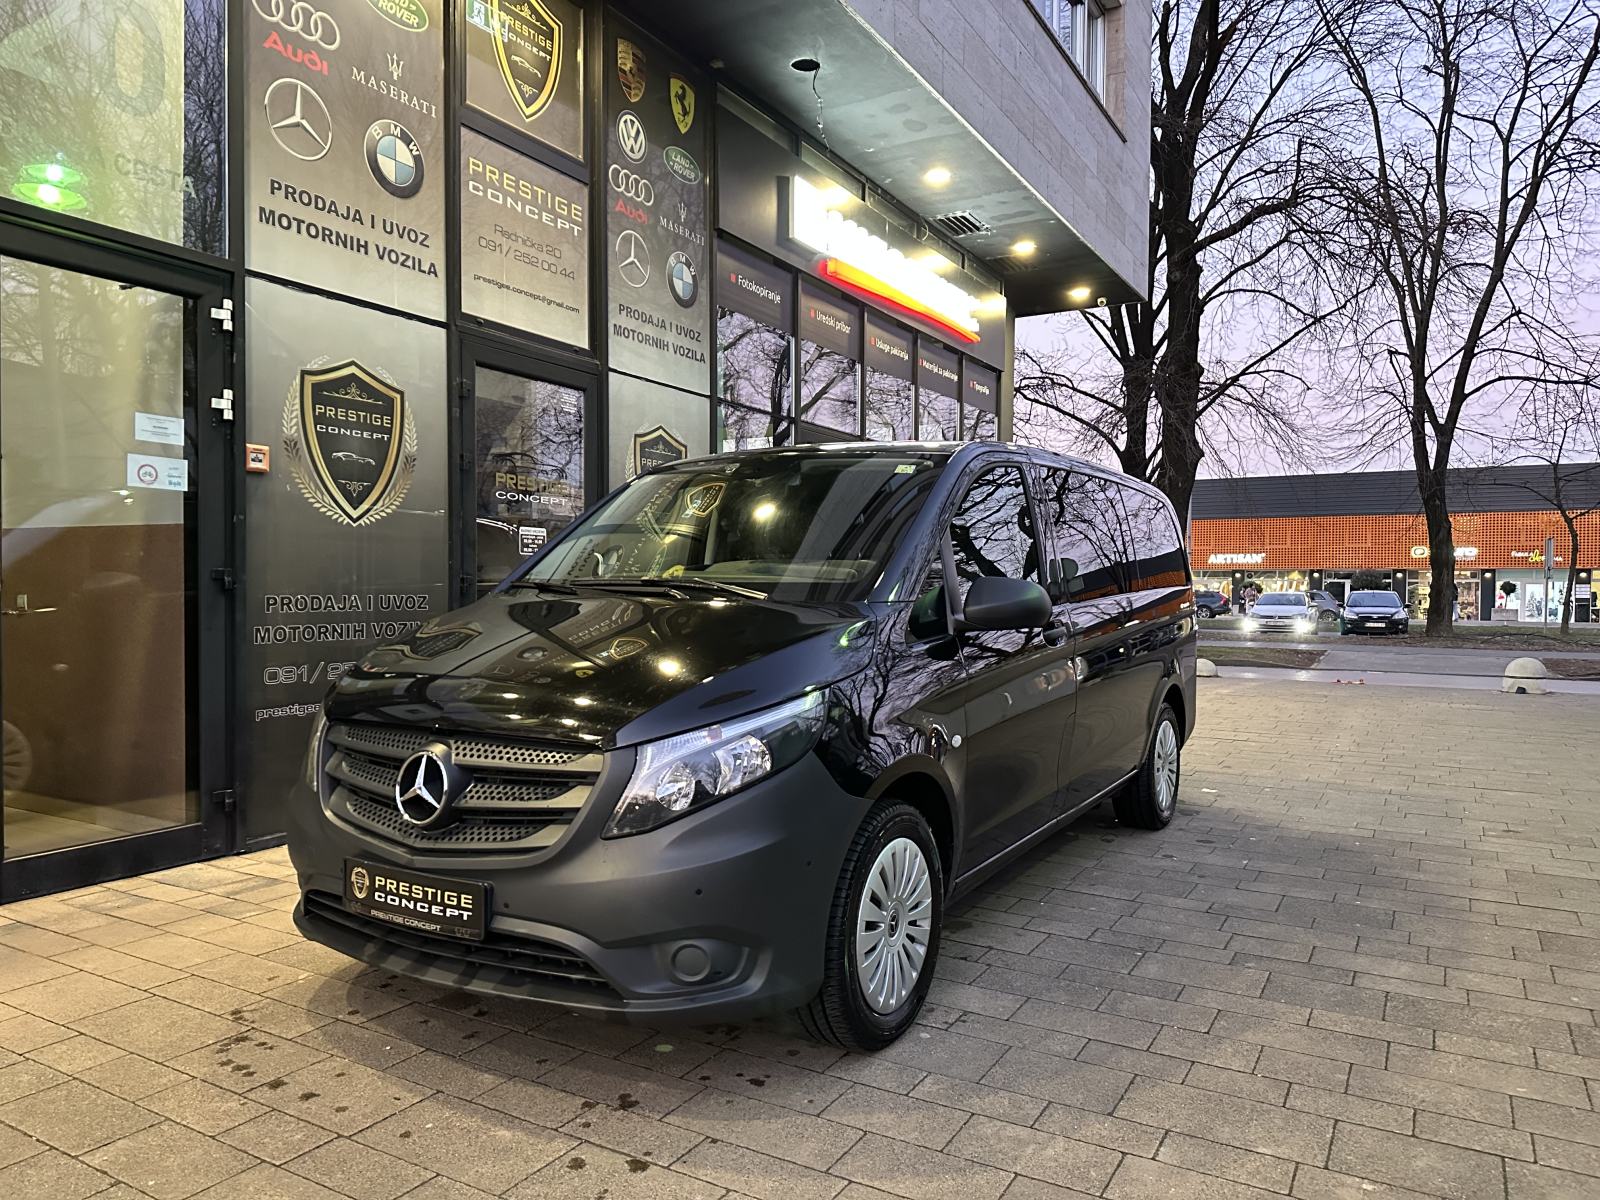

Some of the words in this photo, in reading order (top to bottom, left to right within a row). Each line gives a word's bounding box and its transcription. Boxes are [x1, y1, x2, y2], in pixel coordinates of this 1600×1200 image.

[378, 0, 419, 28] ROVER
[500, 11, 553, 51] PRESTIGE
[501, 28, 551, 61] CONCEPT
[263, 31, 329, 76] Audi
[352, 66, 437, 118] MASERATI
[372, 124, 420, 156] BMW
[671, 151, 691, 169] LAND
[674, 163, 696, 181] ROVER
[469, 157, 583, 222] PRESTIGE
[270, 178, 364, 226] PRODAJA
[370, 213, 376, 229] I
[382, 218, 430, 248] UVOZ
[469, 181, 582, 236] CONCEPT
[615, 198, 648, 225] Audi
[258, 206, 369, 256] MOTORNIH
[375, 243, 439, 278] VOZILA
[494, 224, 544, 253] Radnička
[545, 245, 562, 259] 20
[659, 216, 705, 247] MASERATI
[479, 236, 503, 254] 091
[513, 249, 539, 268] 252
[541, 260, 558, 275] 00
[560, 267, 576, 280] 44
[738, 275, 781, 304] Fotokopiranje
[618, 303, 667, 330] PRODAJA
[676, 320, 702, 343] UVOZ
[816, 310, 835, 327] Uredski
[835, 321, 851, 334] pribor
[613, 323, 670, 353] MOTORNIH
[671, 340, 706, 364] VOZILA
[315, 404, 392, 428] PRESTIGE
[316, 424, 391, 441] CONCEPT
[495, 490, 568, 506] CONCEPT
[496, 472, 570, 495] PRESTIGE
[1208, 553, 1263, 565] ARTISAN
[264, 594, 362, 613] PRODAJA
[366, 594, 374, 612] I
[378, 594, 429, 612] UVOZ
[253, 622, 366, 645] MOTORNIH
[370, 621, 421, 639] VOZ
[264, 664, 309, 685] 091
[374, 892, 473, 921] CONCEPT
[375, 875, 473, 909] PRESTIGE
[370, 909, 404, 924] PRESTIGE
[404, 917, 441, 932] CONCEPT
